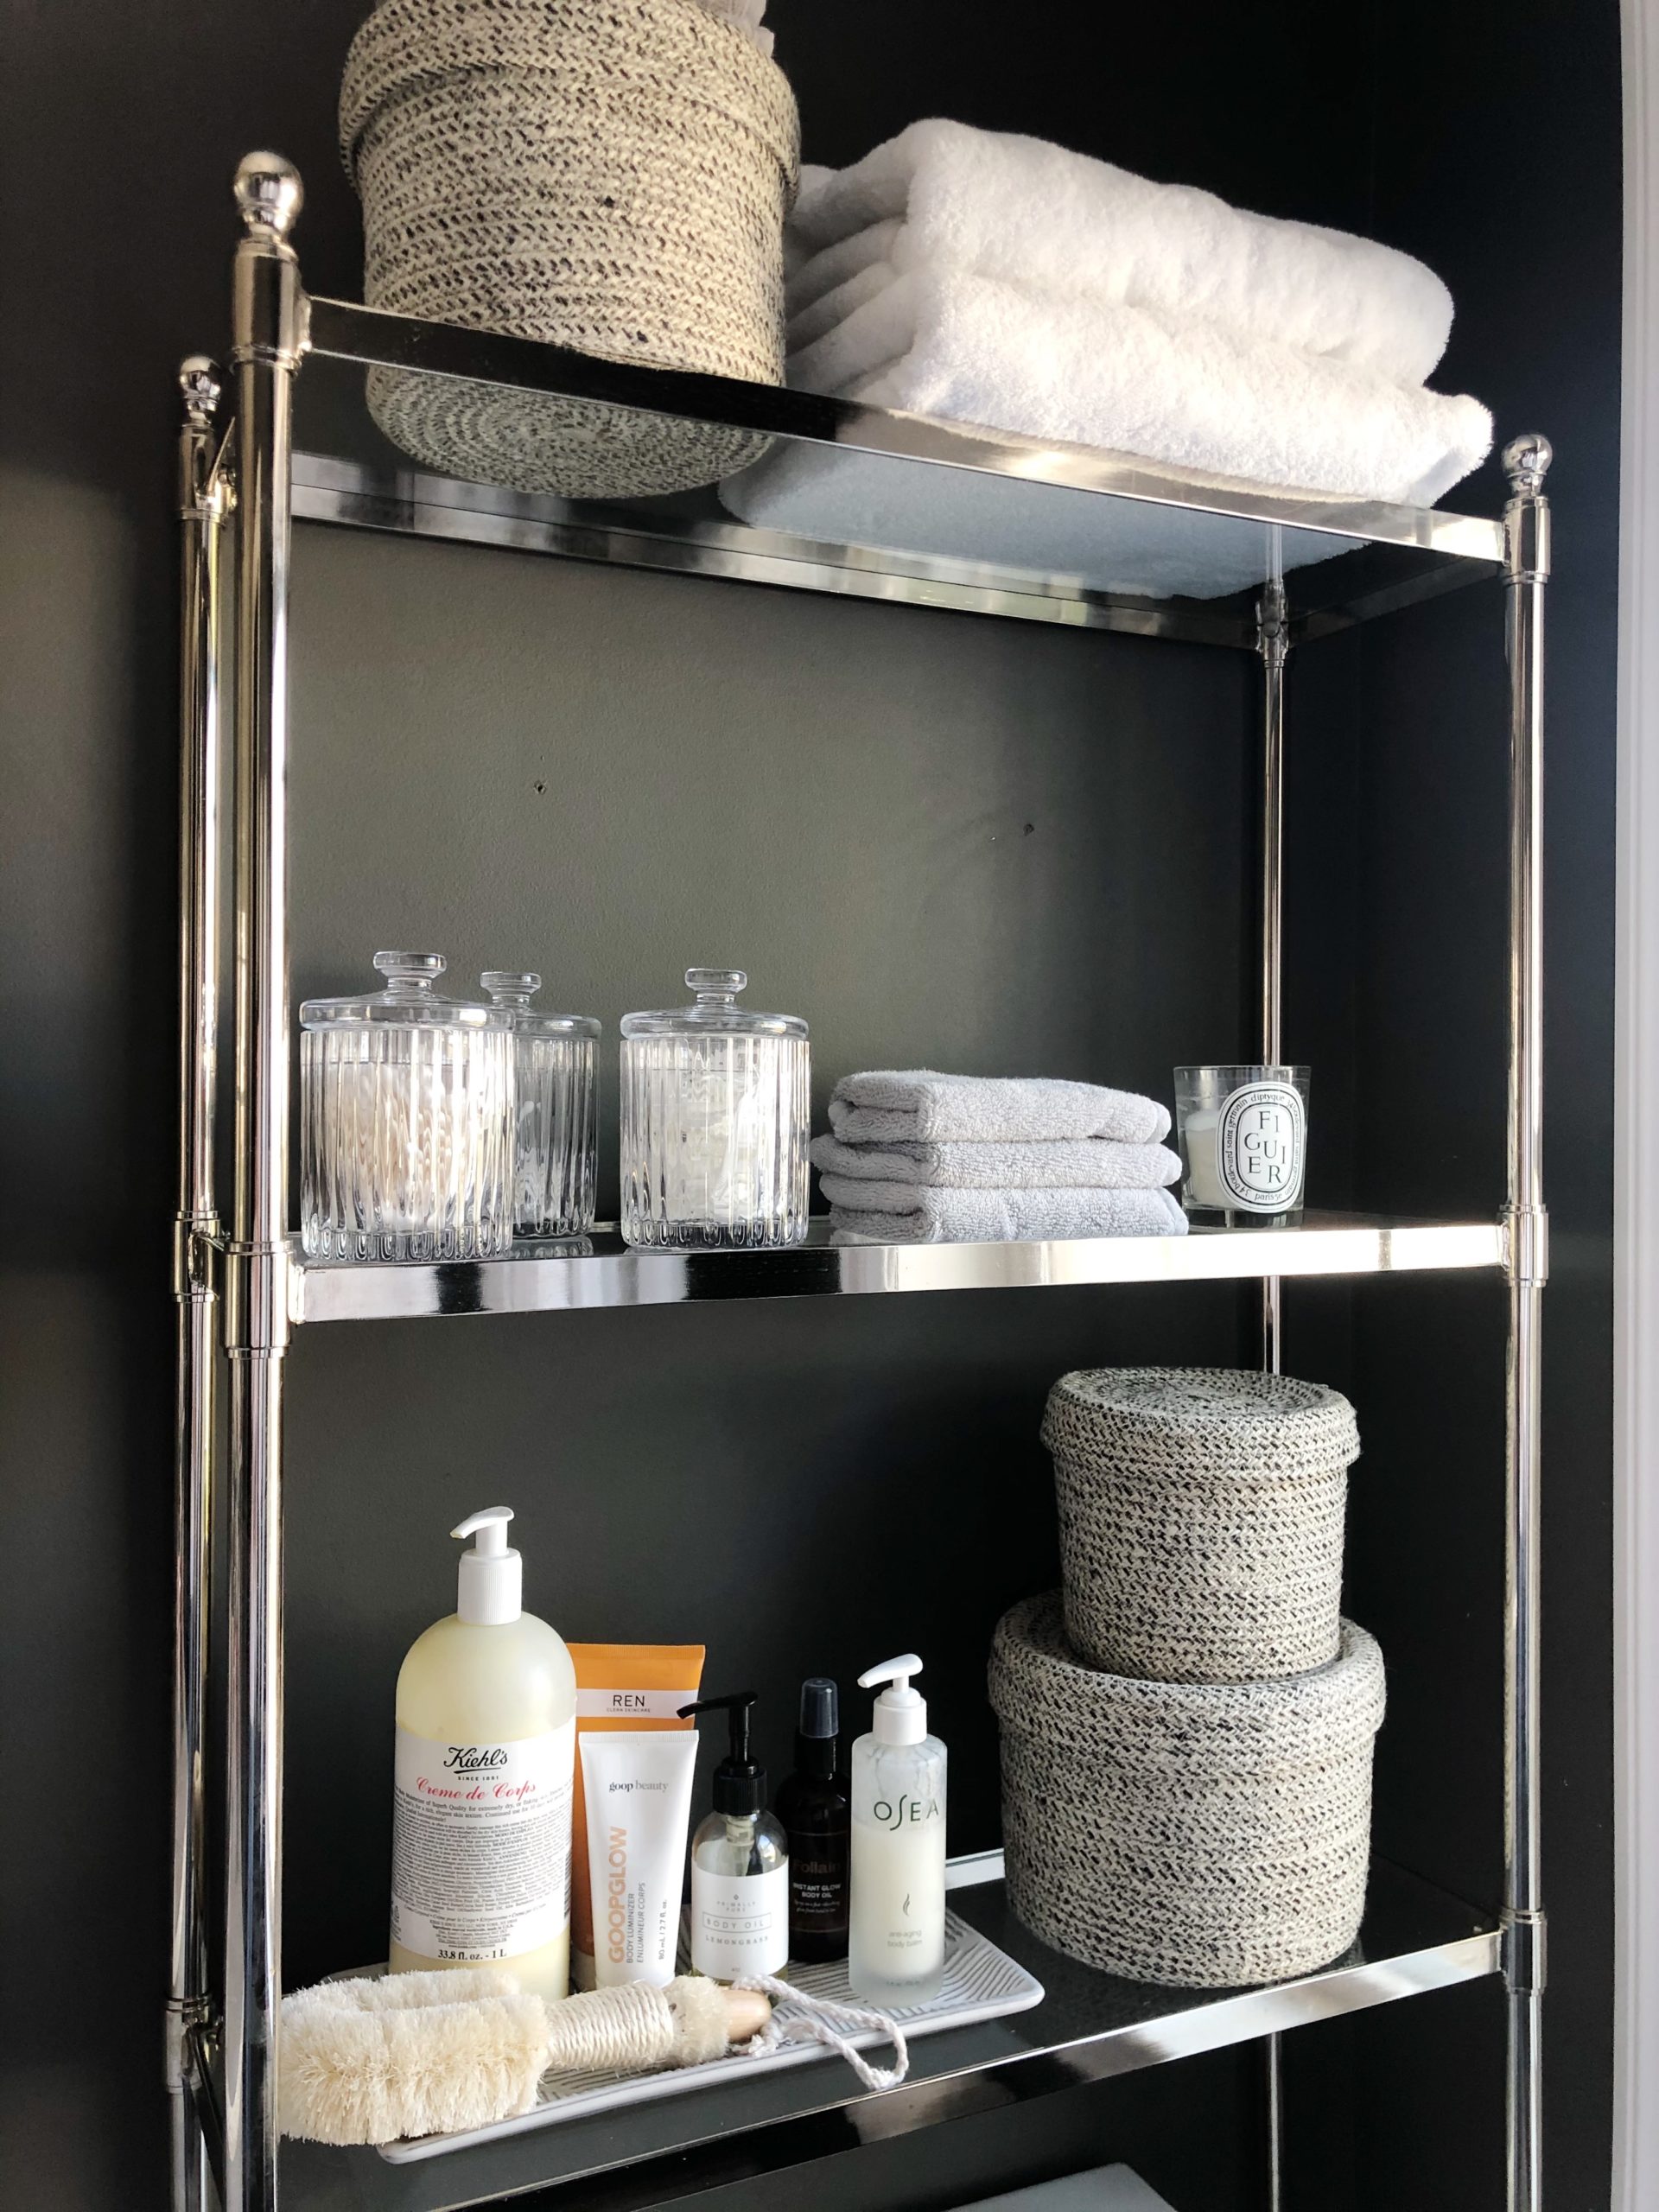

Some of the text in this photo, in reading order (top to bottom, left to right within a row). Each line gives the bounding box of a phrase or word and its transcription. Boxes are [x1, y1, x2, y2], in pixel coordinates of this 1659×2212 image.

[1251, 1093, 1285, 1103] diptyque
[613, 1694, 645, 1707] REN
[443, 1746, 508, 1768] Kiehl's
[416, 1777, 464, 1799] Creme
[466, 1785, 486, 1800] de
[493, 1780, 536, 1802] Corps
[609, 1779, 669, 1793] goop beauty
[874, 1794, 940, 1832] OSEA
[608, 1826, 627, 1963] GOOPGLOW
[707, 1918, 763, 1929] BODY OIL
[637, 1910, 645, 1963] ENLUMINEUR
[705, 1935, 768, 1945] LEMONGRASS
[438, 1948, 456, 1960] 33.8
[458, 1951, 468, 1960] fl.
